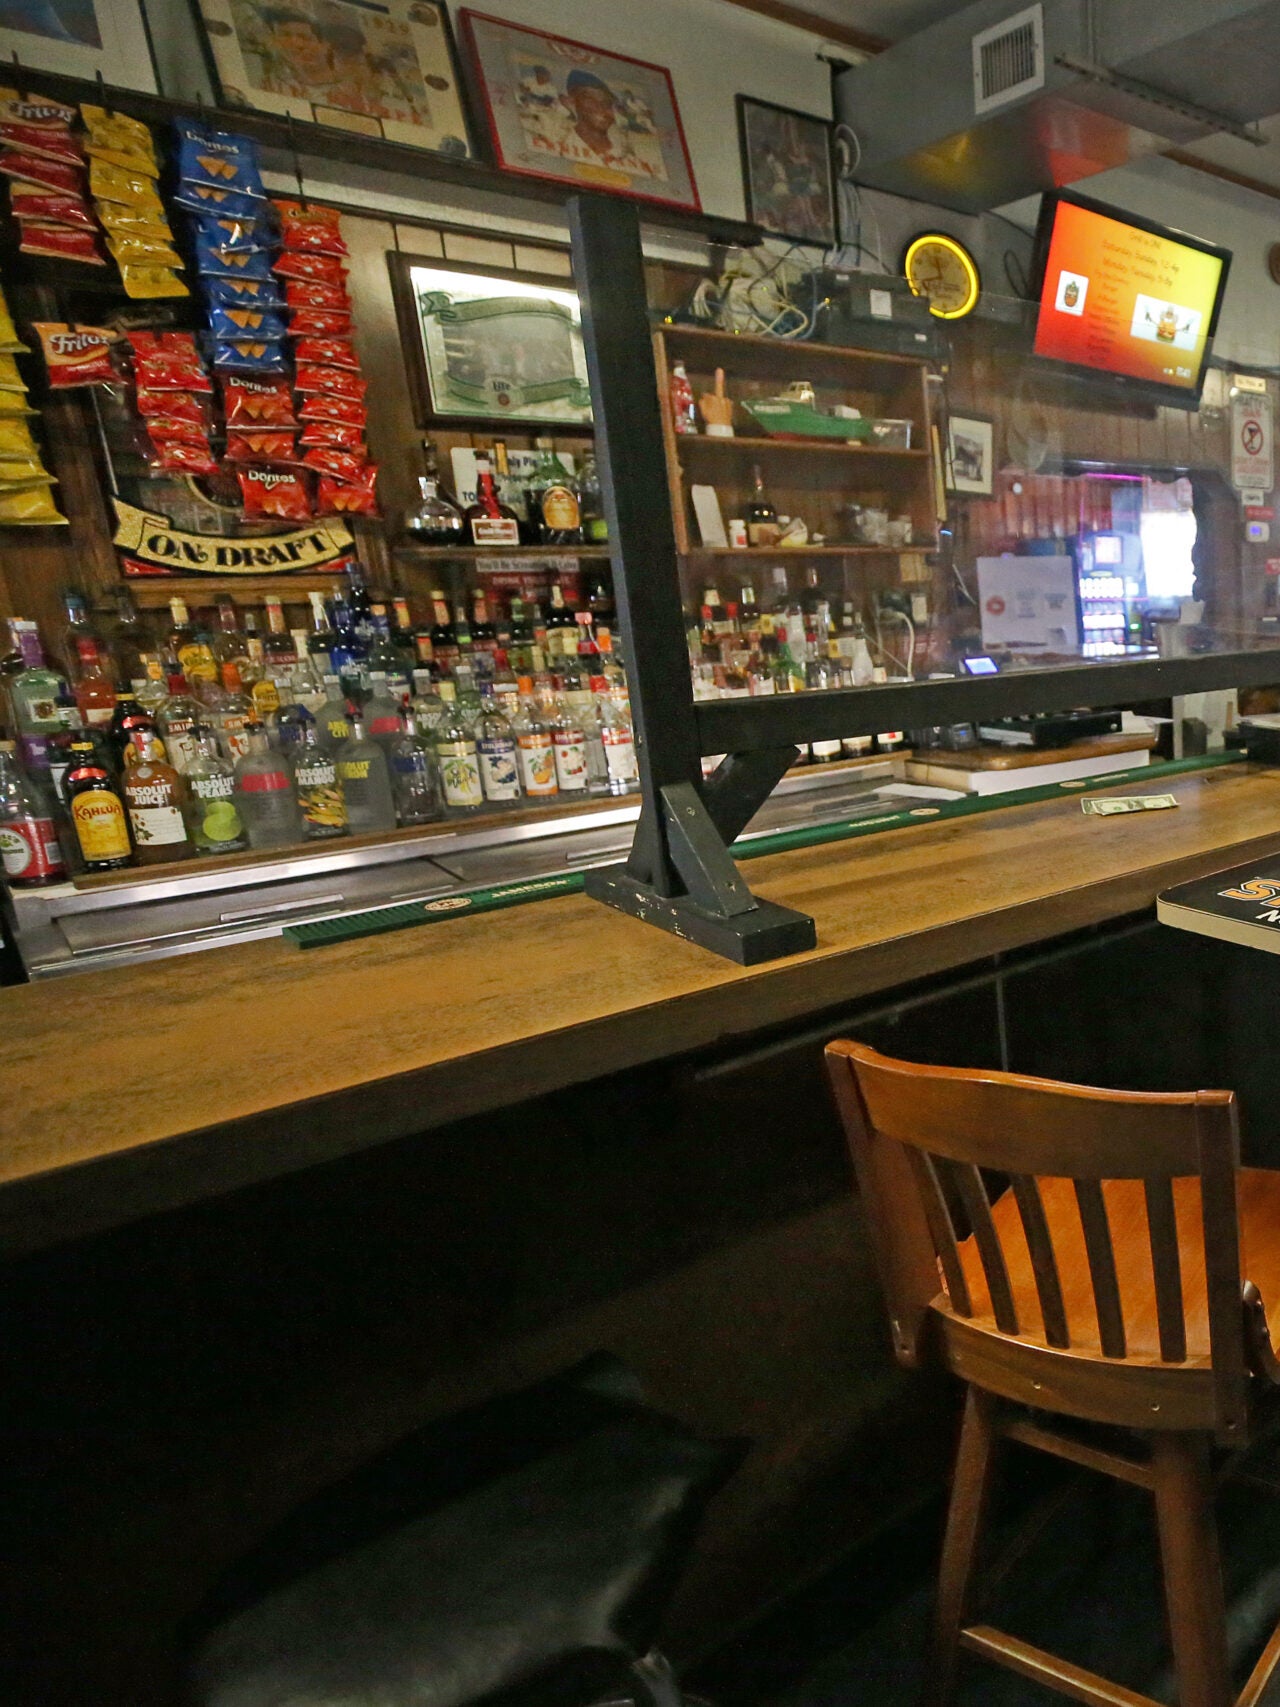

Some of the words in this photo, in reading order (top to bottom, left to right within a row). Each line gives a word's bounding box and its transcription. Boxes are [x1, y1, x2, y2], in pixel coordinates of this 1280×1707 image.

[9, 101, 73, 123] Fritos
[185, 130, 240, 156] Doritos
[50, 332, 110, 355] Fritos
[229, 376, 278, 395] Doritos
[248, 469, 296, 489] Doritos
[147, 534, 208, 564] ON
[216, 531, 328, 567] DRAFT
[295, 765, 336, 777] ABSOLUT
[125, 784, 172, 796] ABSOLUT
[191, 777, 235, 790] ABSOLUT
[492, 879, 567, 898] JAMESON
